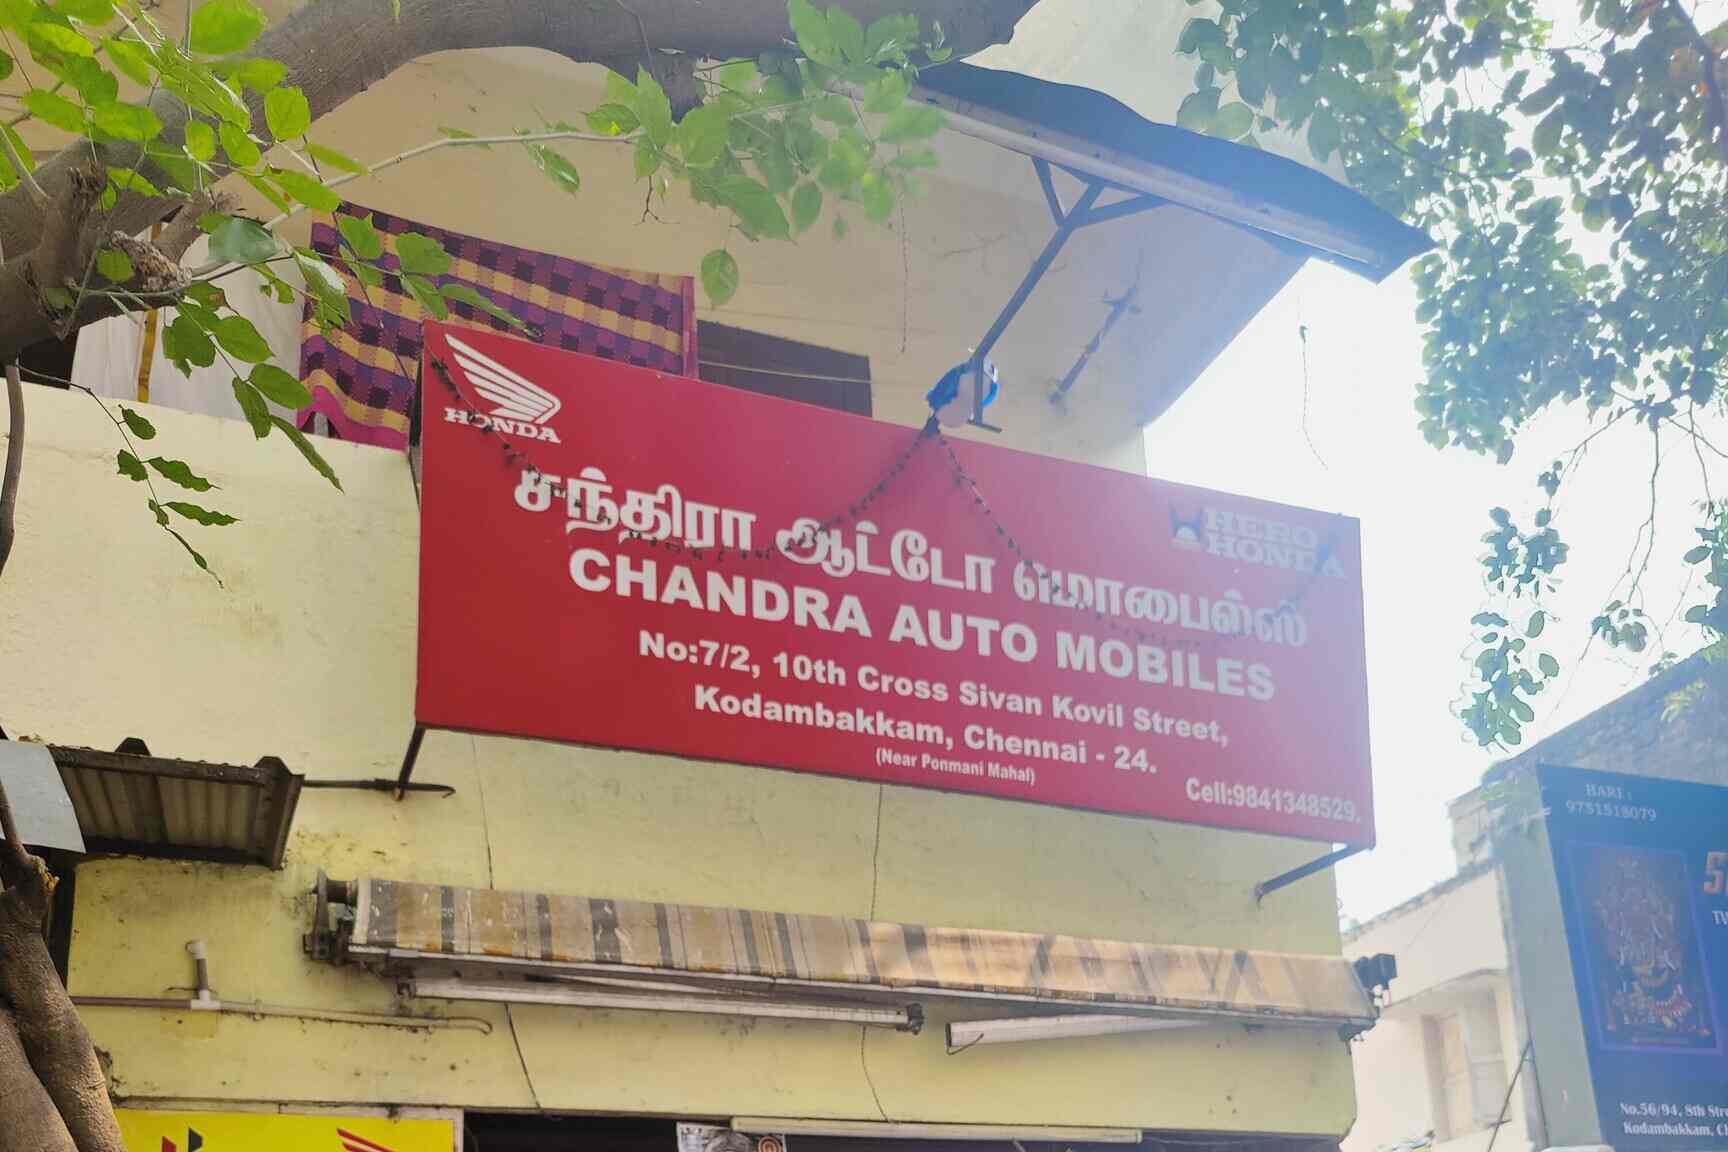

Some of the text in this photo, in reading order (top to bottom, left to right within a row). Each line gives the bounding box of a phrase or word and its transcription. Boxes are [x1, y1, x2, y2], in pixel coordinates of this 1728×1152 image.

[443, 407, 561, 443] HONDA
[513, 466, 757, 550] சந்திரா
[775, 517, 996, 593] ஆட்டோ
[1203, 508, 1318, 549] HERO
[1204, 533, 1346, 578] HONDA
[569, 548, 1275, 701] CHANDRA AUTO MOBILES
[639, 630, 1229, 747] No:7/2, 10th Cross Sivan Kovil Street,
[694, 685, 954, 750] Kodambakkam,
[964, 724, 1087, 764] Chennai
[875, 748, 1036, 786] (Near Ponmani Mahal)
